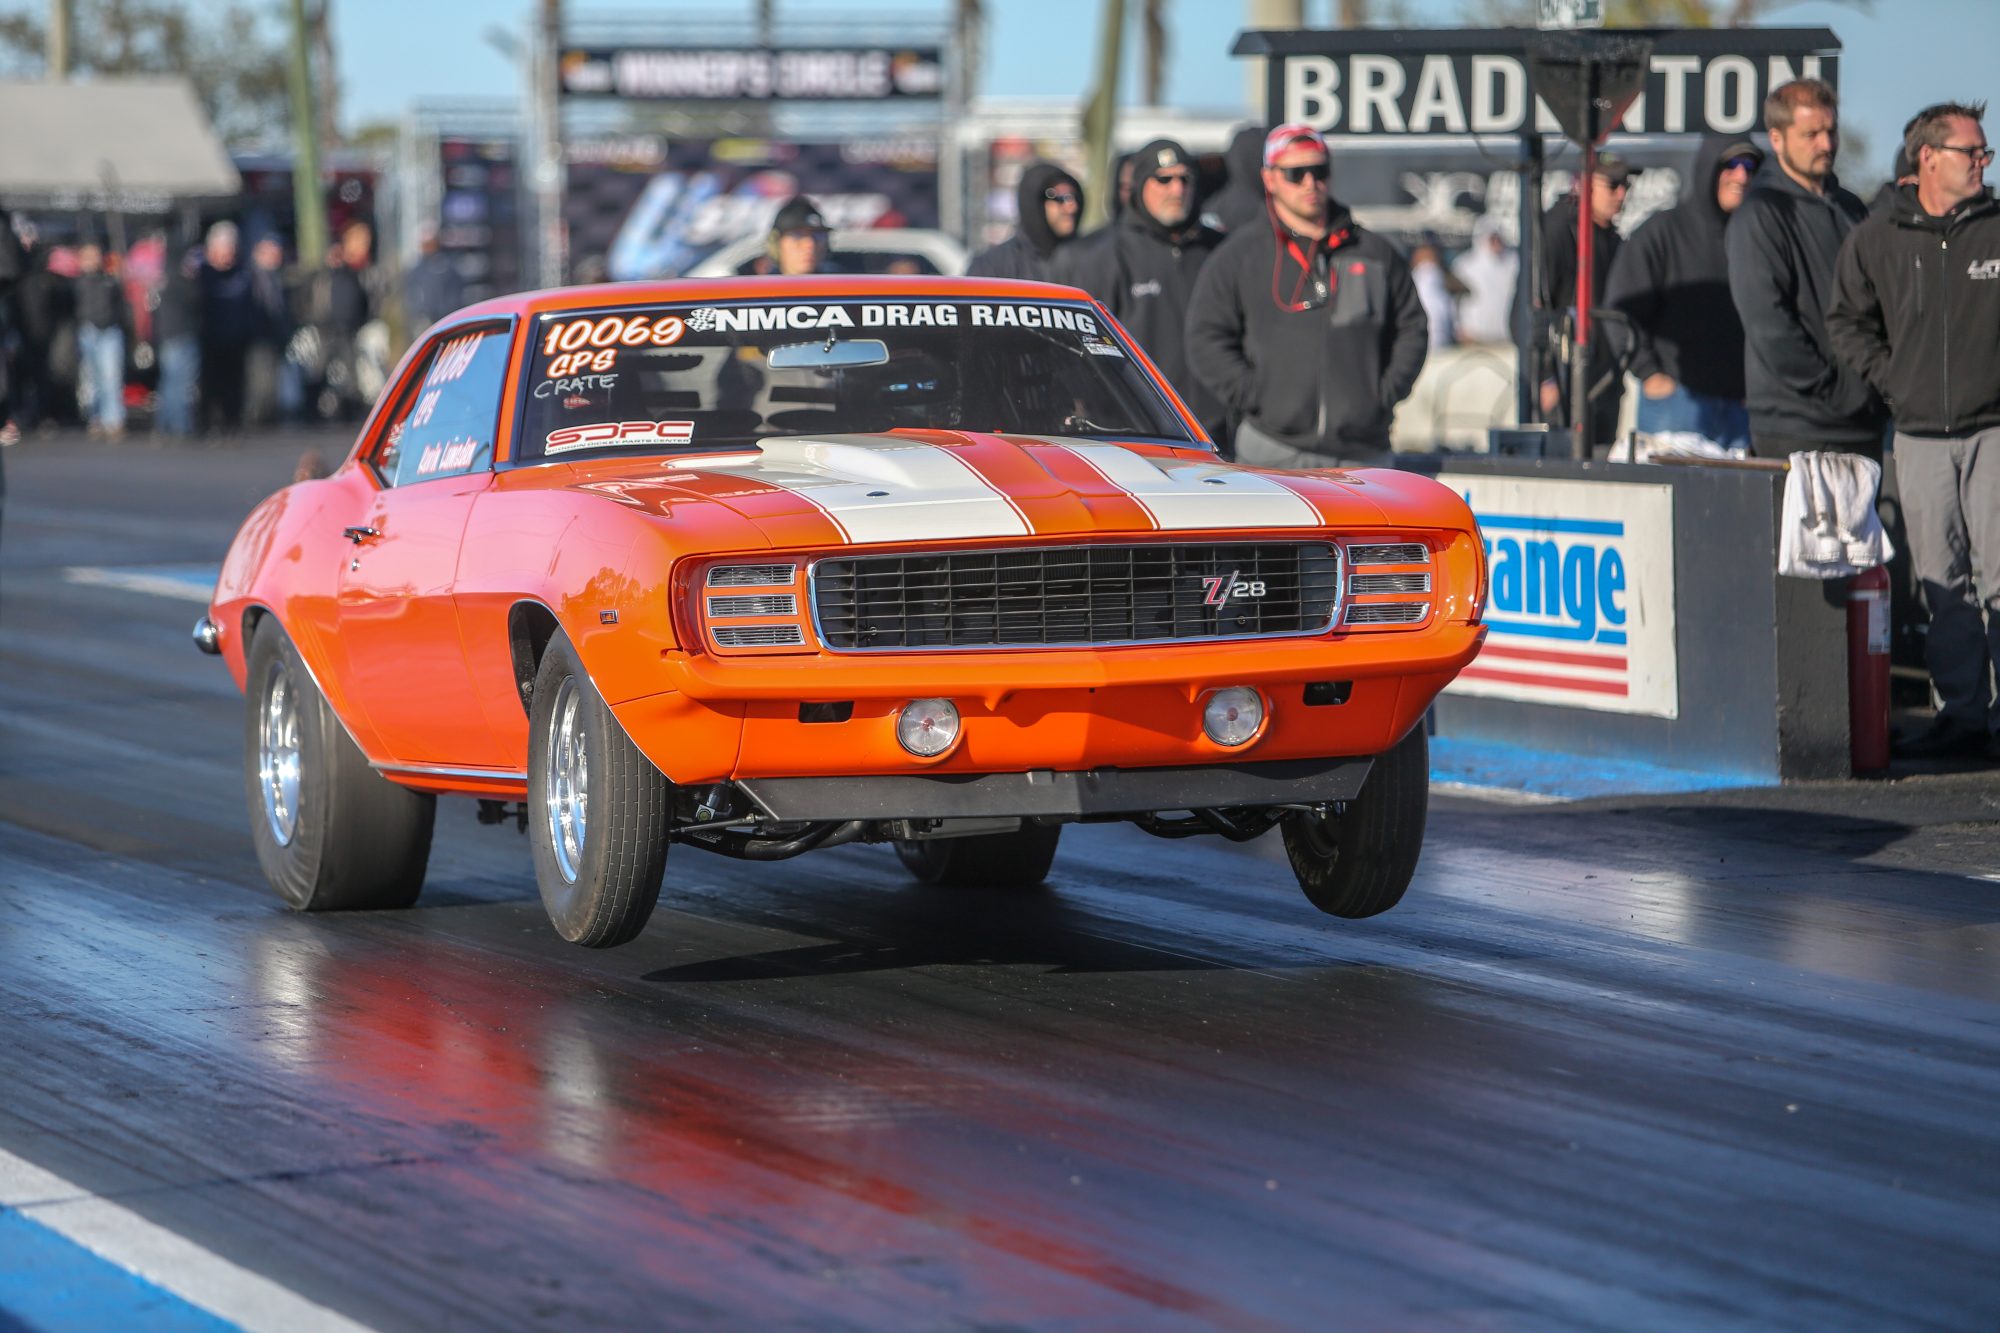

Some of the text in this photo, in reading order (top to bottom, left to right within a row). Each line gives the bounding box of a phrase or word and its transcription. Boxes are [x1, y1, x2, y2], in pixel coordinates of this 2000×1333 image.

[1284, 54, 1822, 134] BRADTO
[544, 315, 686, 355] 10069
[715, 304, 1098, 334] NMCA DRAG RACING
[547, 348, 617, 378] CPS
[534, 373, 619, 399] CRATE
[1202, 570, 1266, 610] Z/28
[1485, 537, 1627, 642] ange
